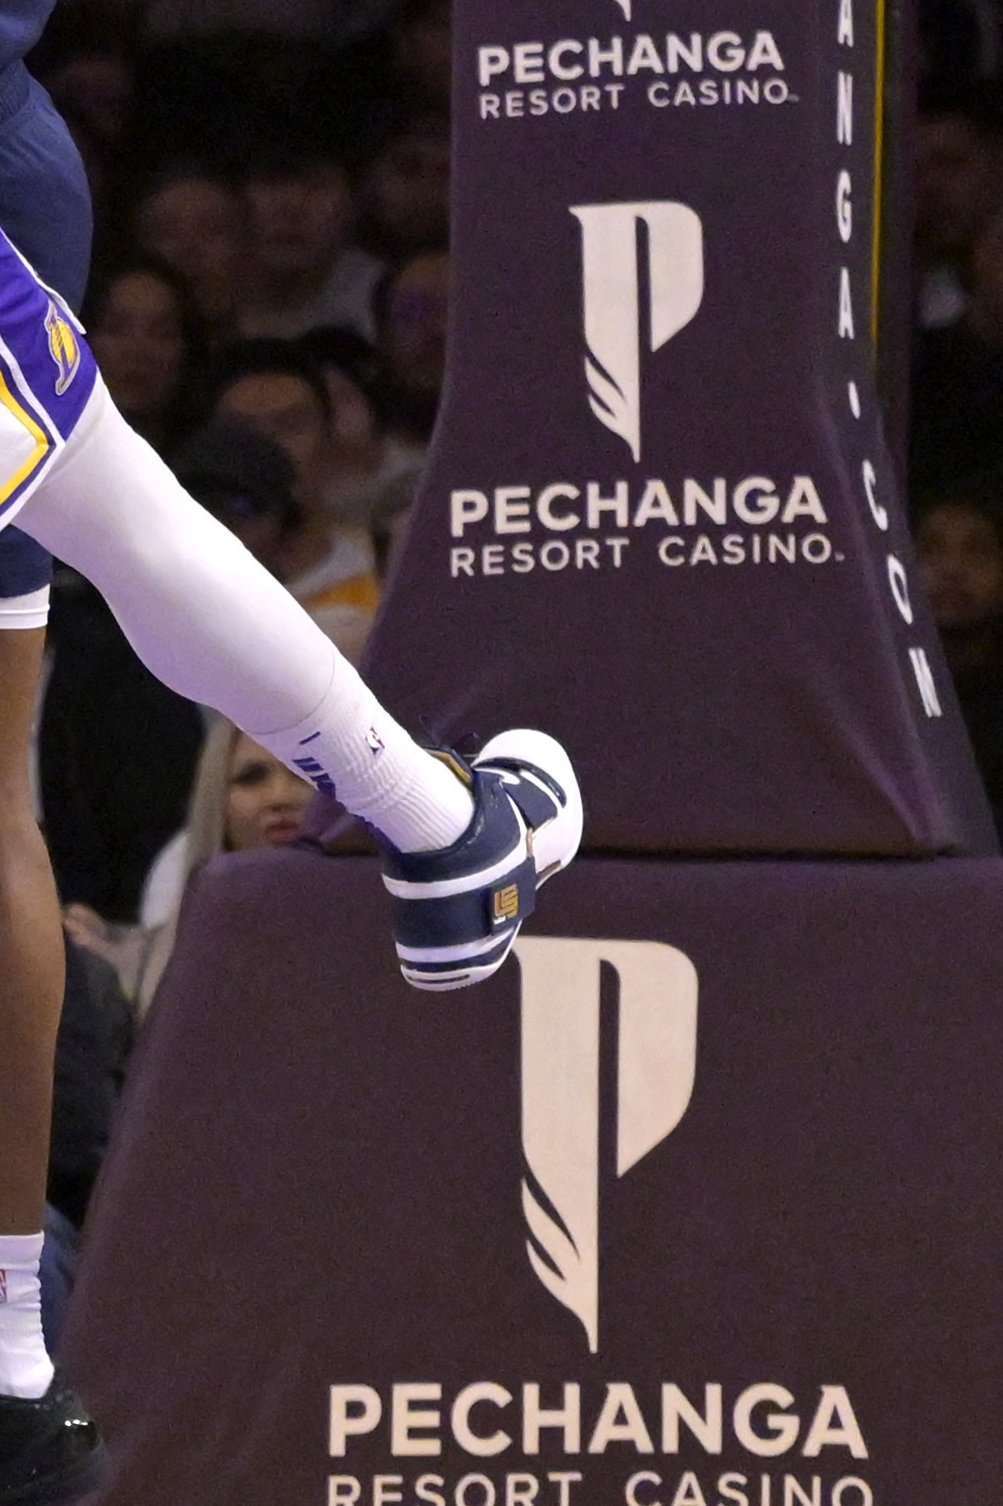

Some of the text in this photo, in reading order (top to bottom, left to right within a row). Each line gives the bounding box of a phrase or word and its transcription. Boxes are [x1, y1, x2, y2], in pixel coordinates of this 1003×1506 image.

[477, 30, 786, 86] PECHANGA
[479, 78, 789, 120] RESORT CASINO
[450, 475, 828, 538] PECHANGA
[449, 532, 833, 578] RESORT CASINO
[328, 1381, 870, 1459] PECHANGA
[327, 1470, 874, 1506] RESORT CASINO
